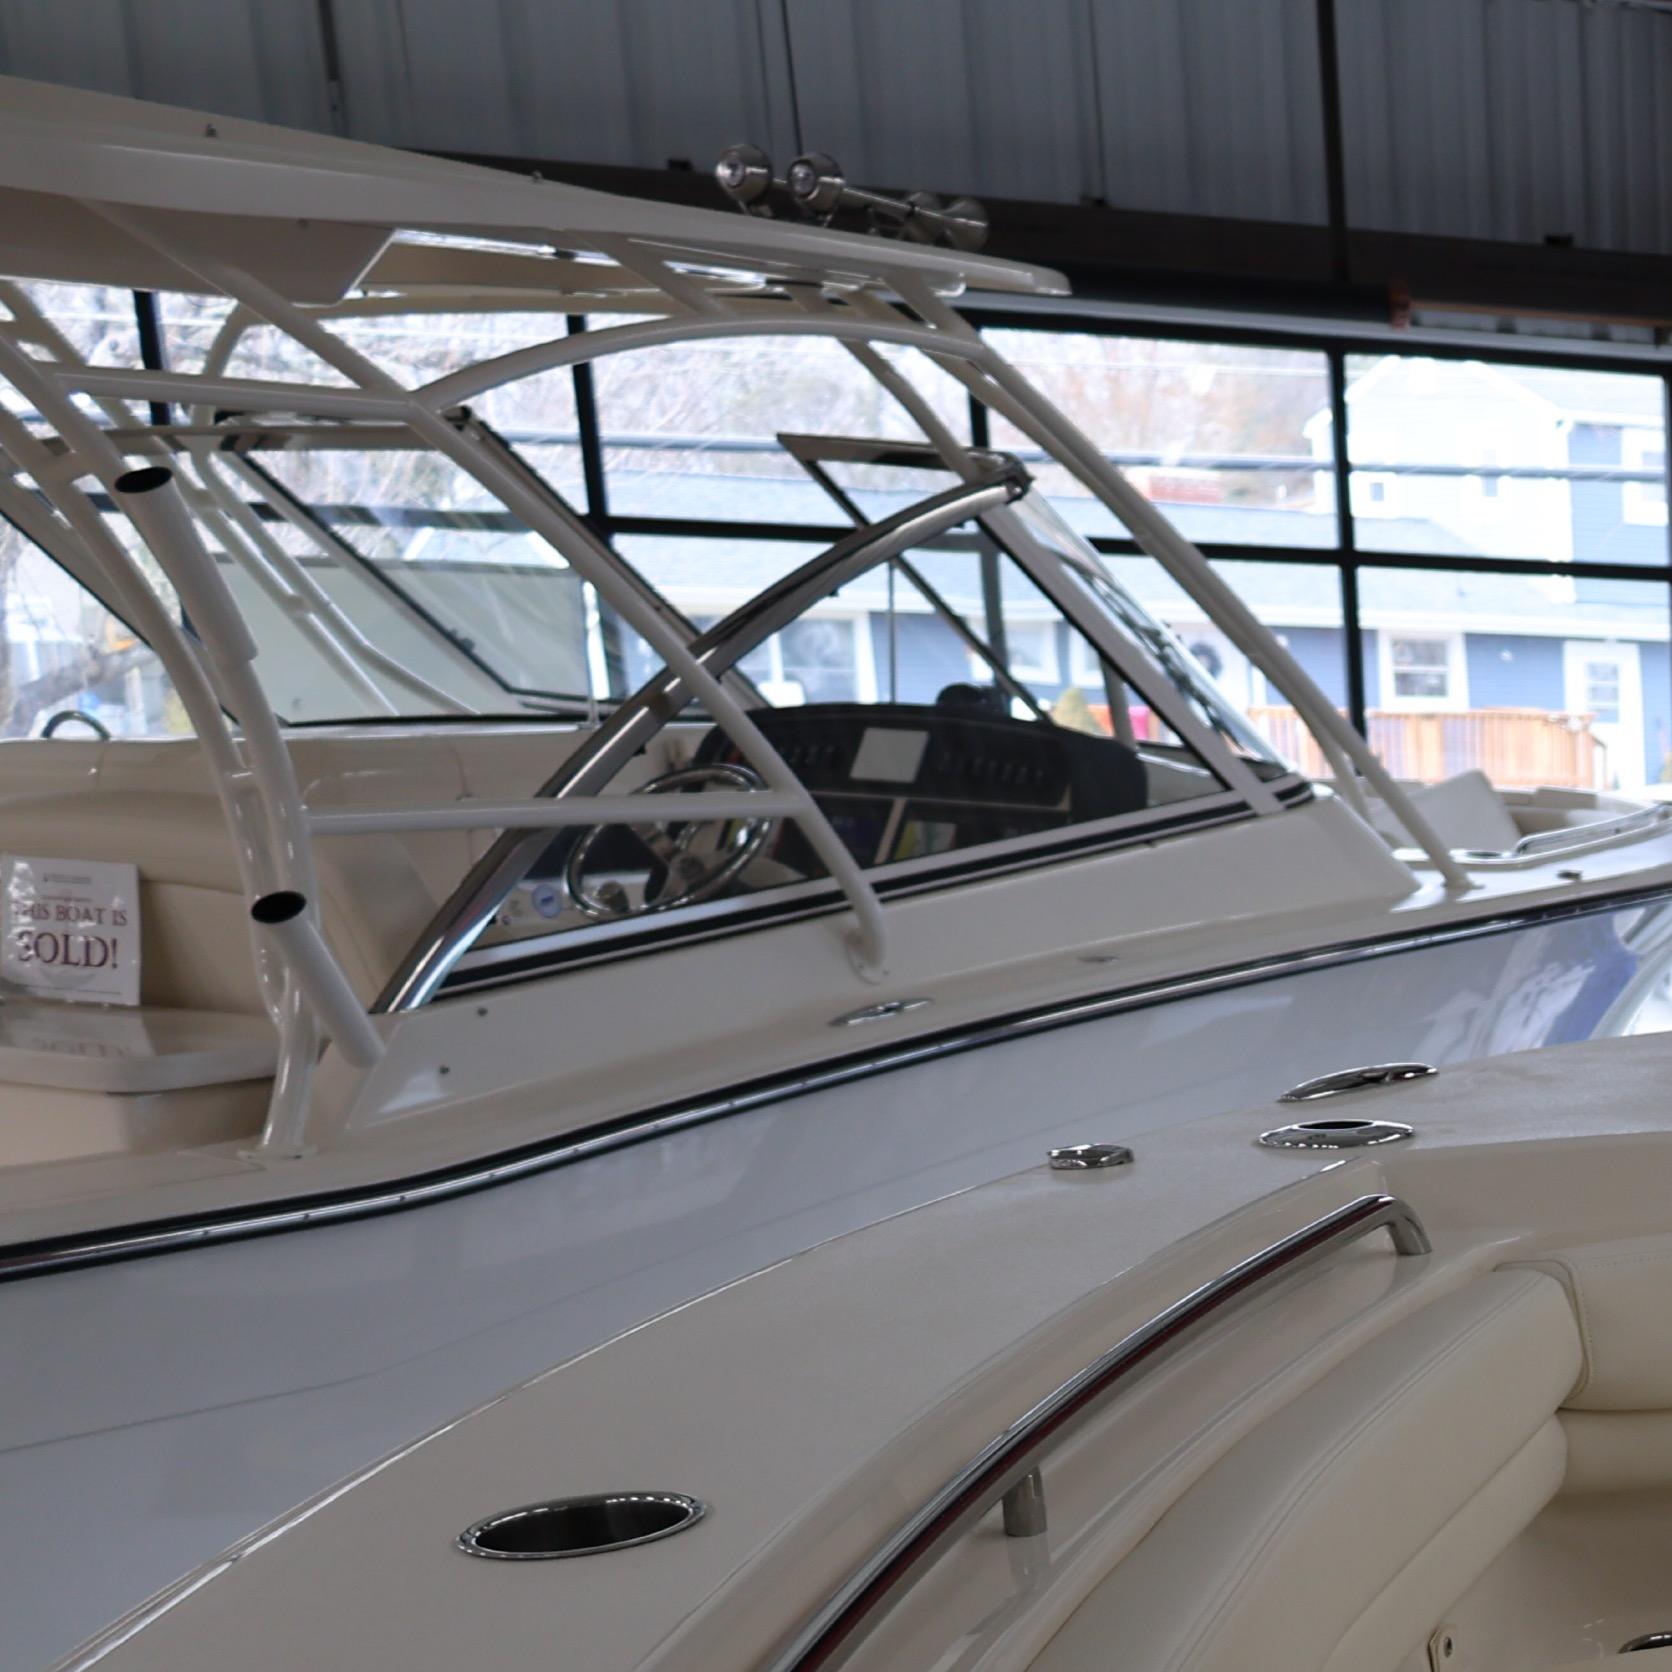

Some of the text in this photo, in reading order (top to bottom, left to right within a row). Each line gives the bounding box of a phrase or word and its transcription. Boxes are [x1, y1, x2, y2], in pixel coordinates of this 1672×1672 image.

[56, 904, 106, 923] BOAT
[112, 909, 128, 927] IS
[18, 930, 118, 969] SOLD!
